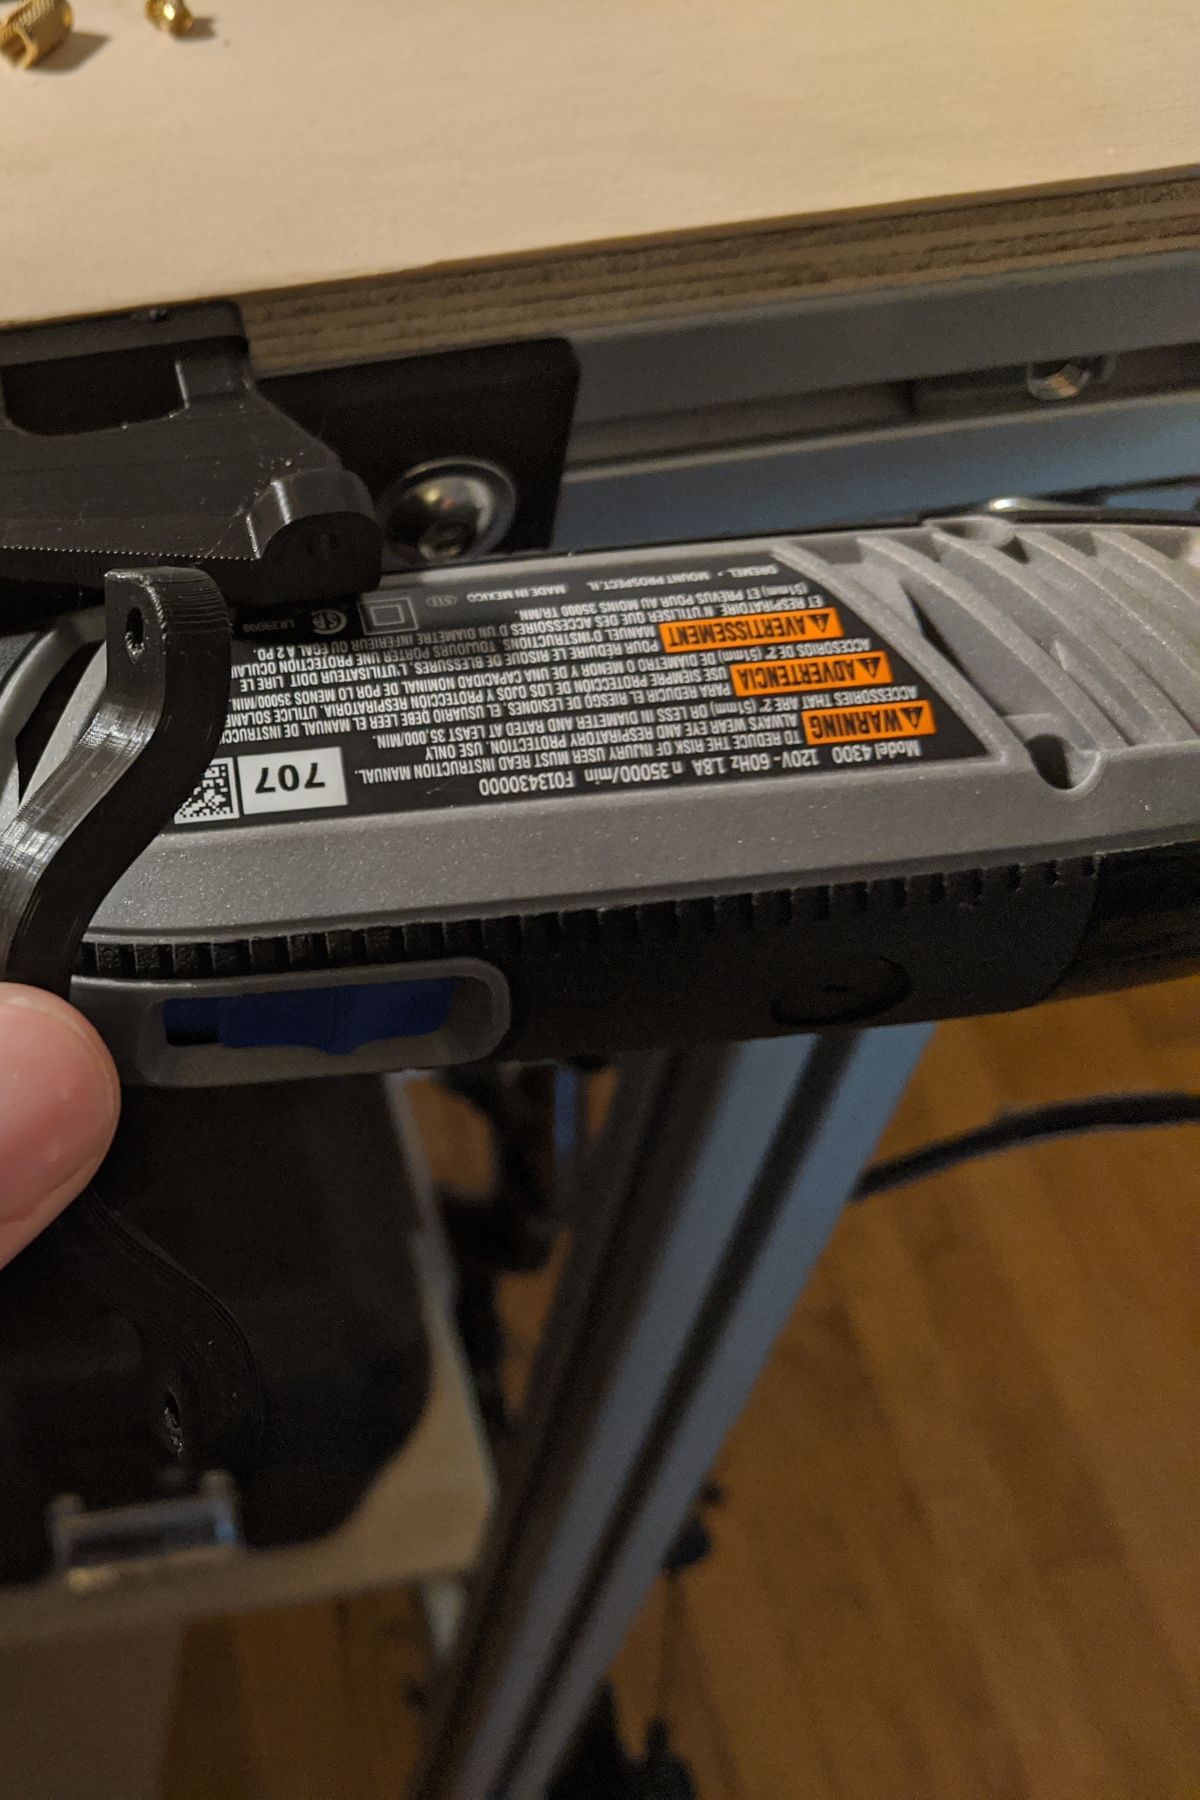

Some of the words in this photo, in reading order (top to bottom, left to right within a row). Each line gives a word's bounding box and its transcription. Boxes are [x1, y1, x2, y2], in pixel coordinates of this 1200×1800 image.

[465, 588, 513, 602] MEXICO
[514, 587, 529, 598] IN
[530, 583, 566, 597] MADE
[744, 585, 760, 599] ET
[597, 597, 639, 613] MOINS
[640, 595, 658, 609] AU
[659, 592, 693, 607] POUR
[806, 594, 823, 608] ET
[560, 601, 596, 617] 35000
[509, 616, 591, 636] ACCESSOIRES
[593, 613, 618, 628] DES
[619, 611, 645, 625] QUE
[603, 624, 656, 642] MANUEL
[666, 615, 806, 646] AVERTISSEMENT
[276, 646, 285, 658] 2
[329, 639, 348, 653] OU
[382, 646, 430, 663] PORTER
[431, 639, 496, 658] TOUJOURS
[551, 647, 567, 661] LE
[623, 638, 659, 654] POUR
[777, 644, 795, 659] DE
[795, 637, 871, 657] ACCESORIOS
[278, 653, 353, 673] PROTECTION
[354, 650, 380, 666] UNE
[484, 653, 502, 667] DE
[503, 649, 549, 666] RISQUE
[625, 659, 635, 673] O
[698, 651, 716, 666] DE
[319, 662, 407, 683] L'UTILISATEUR
[522, 667, 549, 683] UNA
[550, 665, 568, 680] DE
[569, 664, 579, 678] Y
[580, 660, 624, 677] MENOR
[702, 666, 728, 682] USE
[736, 658, 856, 691] ADVERTENCIA
[238, 677, 254, 691] LE
[256, 674, 284, 690] LIRE
[288, 671, 318, 686] DOIT
[400, 676, 455, 694] NOMINAL
[456, 669, 522, 689] CAPACIDAD
[648, 668, 702, 687] SIEMPRE
[293, 687, 335, 705] MENOS
[336, 685, 354, 700] LO
[354, 683, 381, 699] POR
[382, 681, 399, 696] DE
[484, 688, 494, 702] Y
[495, 684, 527, 701] OJOS
[528, 682, 553, 698] LOS
[554, 680, 571, 695] DE
[645, 685, 697, 703] REDUCIR
[698, 682, 731, 698] PARA
[832, 684, 917, 706] ACCESSORIES
[564, 695, 582, 710] DE
[583, 691, 628, 708] RIESGO
[628, 690, 644, 704] EL
[773, 695, 799, 712] ARE
[800, 692, 832, 709] THAT
[272, 704, 317, 722] UTILICE
[431, 704, 485, 723] USUARIO
[485, 703, 501, 718] EL
[639, 708, 654, 724] IN
[655, 705, 687, 722] LESS
[689, 703, 708, 719] OR
[709, 699, 756, 717] (51mm)
[351, 715, 367, 731] EL
[368, 712, 398, 729] LEER
[399, 709, 430, 726] DEBE
[546, 716, 573, 732] AND
[574, 710, 638, 730] DIAMETER
[708, 717, 746, 734] WEAR
[747, 712, 798, 730] ALWAYS
[808, 708, 902, 738] WARNING
[282, 722, 299, 737] DE
[300, 717, 350, 736] MANUAL
[446, 724, 485, 742] LEAST
[487, 722, 503, 738] AT
[504, 718, 545, 736] RATED
[655, 723, 682, 739] AND
[683, 720, 707, 736] EYE
[485, 733, 566, 754] PROTECTION.
[568, 725, 654, 747] RESPIRATORY
[705, 735, 731, 752] THE
[731, 730, 782, 749] REDUCE
[783, 728, 802, 745] TO
[423, 743, 456, 760] ONLY
[457, 741, 483, 757] USE
[607, 742, 653, 761] INJURY
[654, 740, 672, 756] OF
[673, 737, 704, 755] RISK
[830, 743, 873, 764] 4300
[873, 738, 921, 760] Model
[497, 753, 531, 771] READ
[532, 750, 570, 768] MUST
[571, 746, 606, 764] USER
[728, 752, 770, 773] 60Hz
[354, 764, 411, 784] MANUAL.
[412, 757, 495, 779] INSTRUCTION
[583, 761, 670, 786] 35000/min
[250, 761, 325, 794] 707
[477, 770, 575, 795] F013430000
